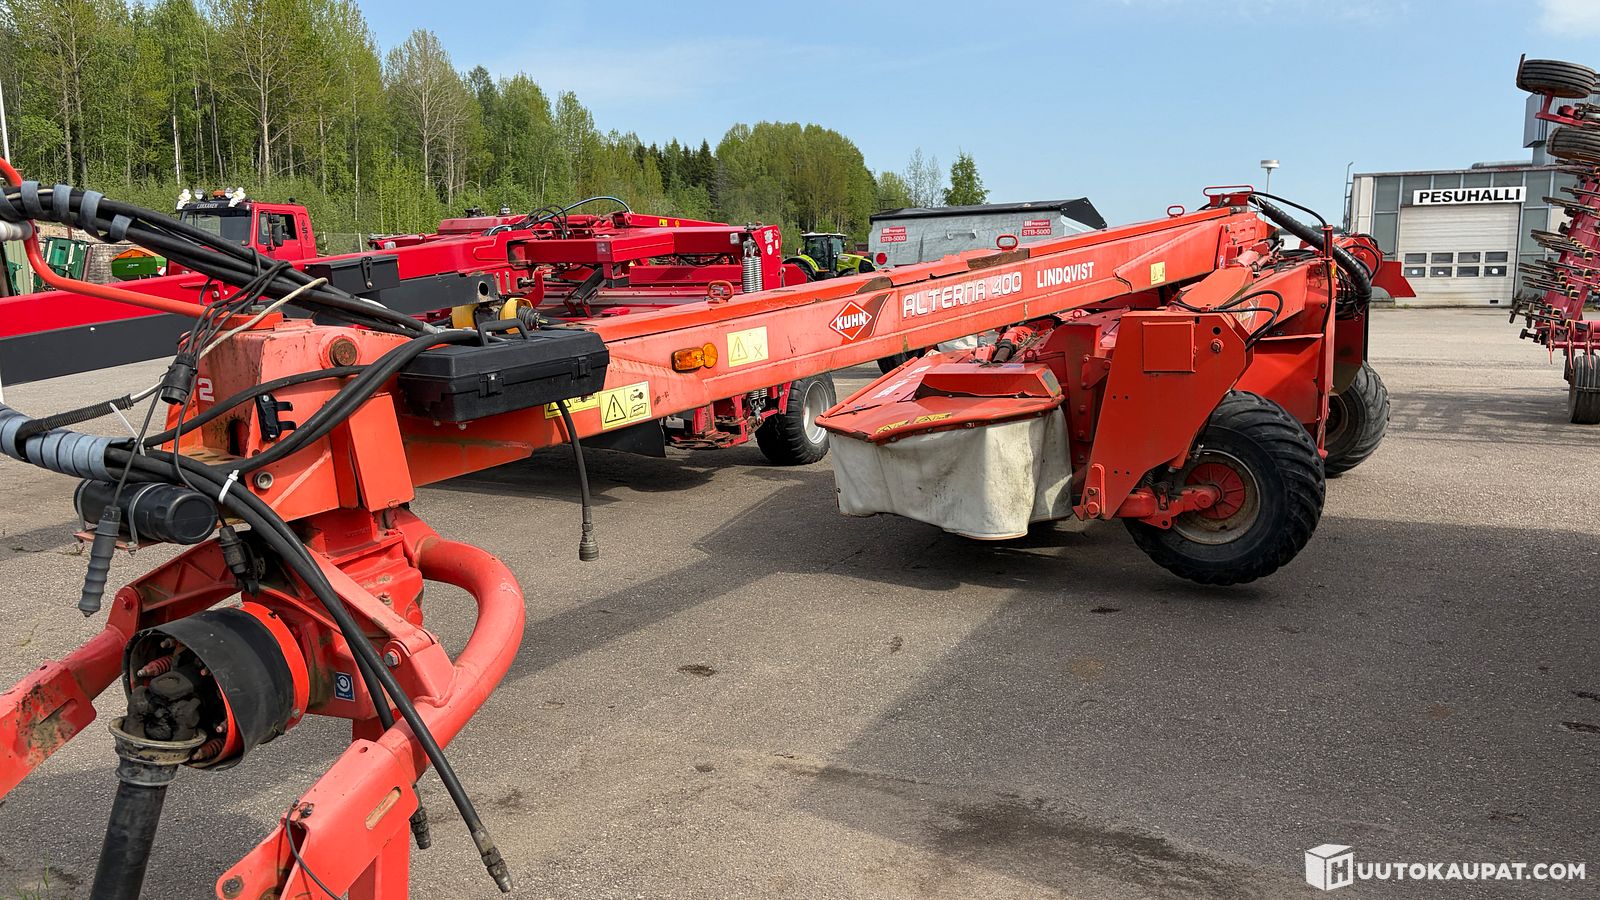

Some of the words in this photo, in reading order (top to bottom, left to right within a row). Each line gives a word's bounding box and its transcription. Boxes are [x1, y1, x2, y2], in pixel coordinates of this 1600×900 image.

[1418, 188, 1520, 203] PESUHALLI
[1036, 262, 1095, 288] LINDQVIST
[903, 279, 986, 318] ALTERNA
[991, 271, 1022, 296] 400
[836, 311, 867, 331] KUHN
